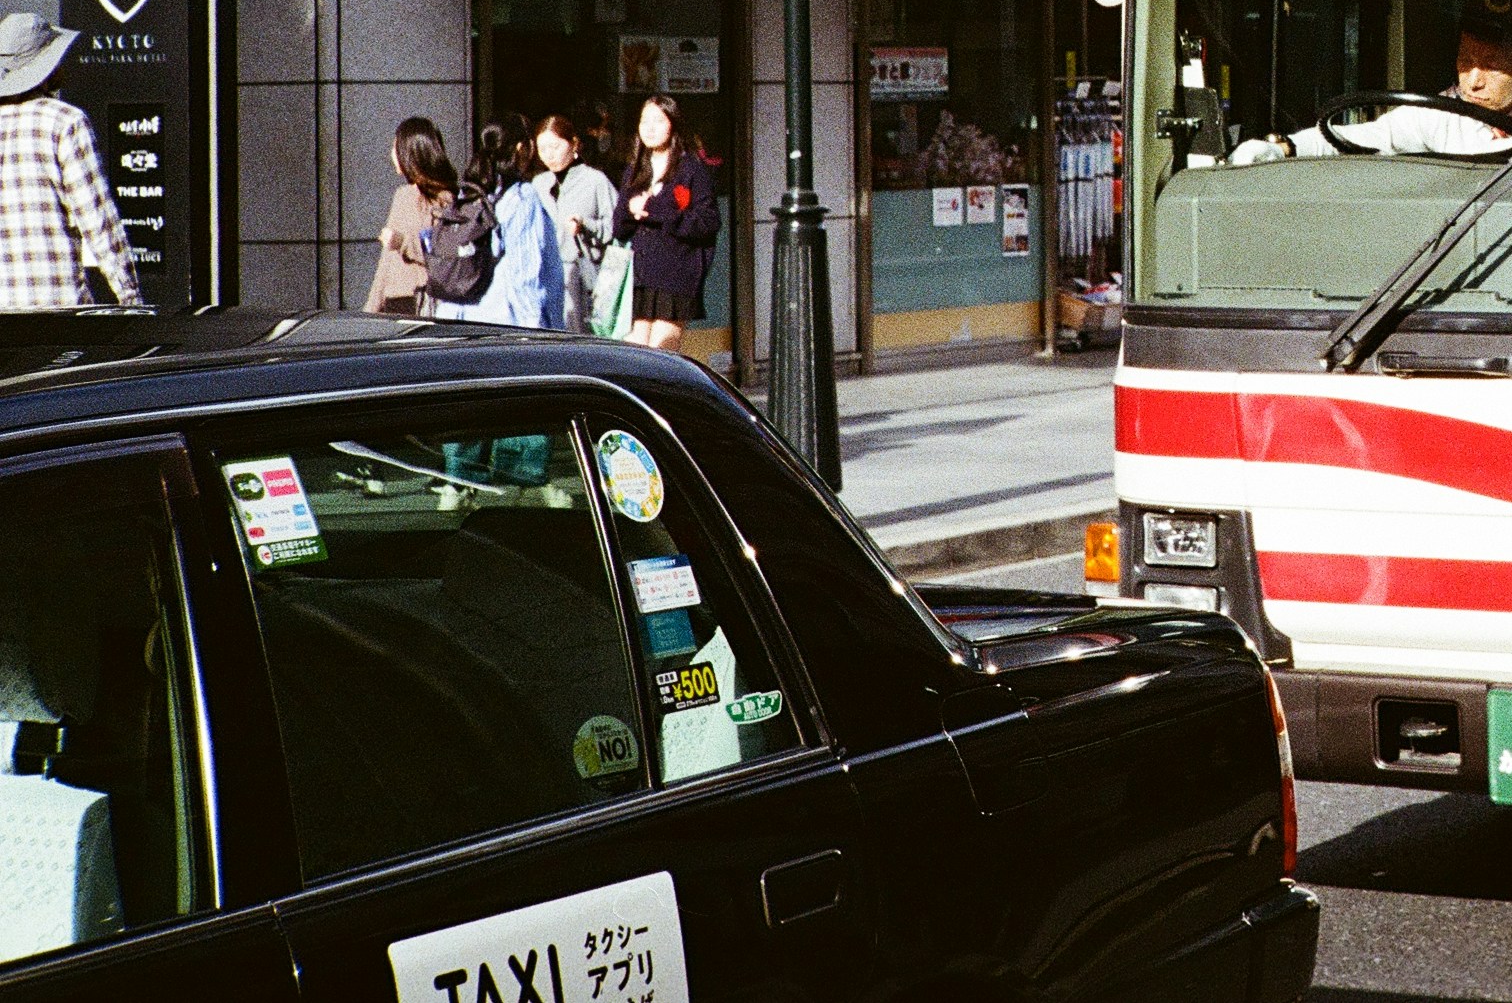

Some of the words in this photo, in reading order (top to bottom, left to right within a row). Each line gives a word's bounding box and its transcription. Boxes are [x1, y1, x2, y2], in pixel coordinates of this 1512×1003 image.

[91, 33, 156, 49] KYOTO
[116, 186, 138, 197] THE
[140, 186, 163, 197] BAR
[672, 665, 717, 701] ¥500
[598, 736, 633, 763] NO!
[584, 924, 649, 960] タクシー
[587, 949, 654, 1000] アプリ
